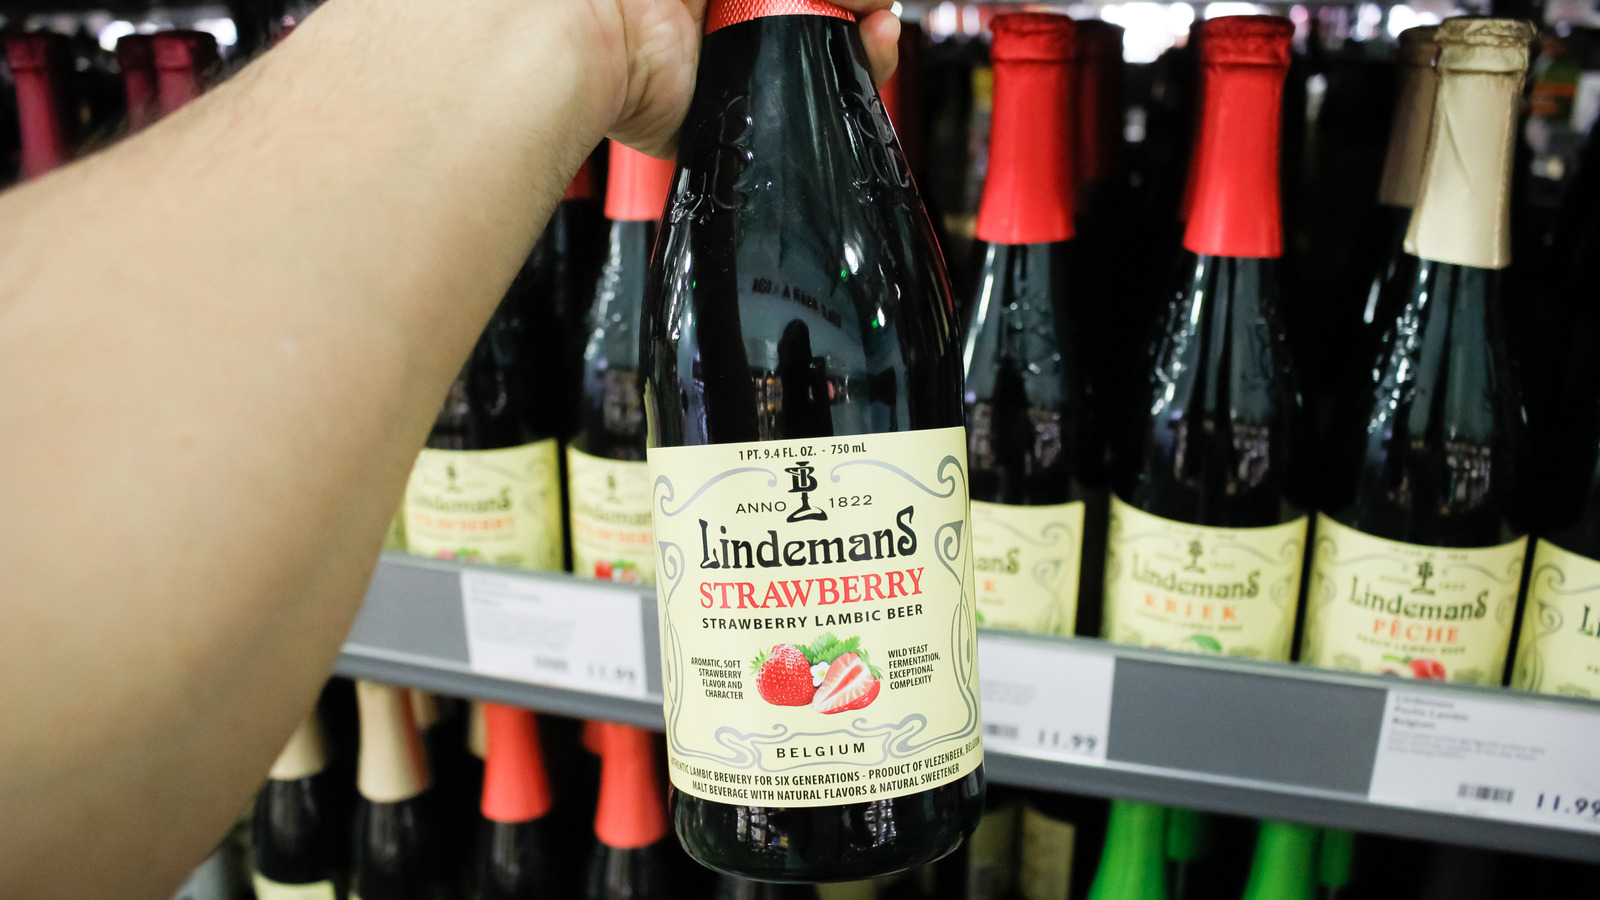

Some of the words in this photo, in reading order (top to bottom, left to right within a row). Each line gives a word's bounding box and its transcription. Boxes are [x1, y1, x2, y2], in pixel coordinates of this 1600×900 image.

[739, 450, 744, 460] 1
[747, 449, 762, 460] PT.
[764, 448, 780, 459] 9.4
[783, 447, 797, 458] FL.
[800, 446, 816, 457] OZ.
[831, 444, 849, 455] 750
[852, 442, 867, 453] mL
[735, 501, 787, 514] ANNO
[828, 495, 873, 508] 1822
[699, 567, 924, 609] STRAWBERRY
[702, 616, 808, 630] STRAWBERRY
[815, 609, 881, 627] LAMBIC
[887, 603, 923, 620] BEER
[888, 648, 908, 658] WILD
[908, 644, 928, 655] YEAST
[691, 657, 723, 668] AROMATIC,
[724, 660, 741, 668] SOFT
[889, 652, 941, 669] FERMENTATION,
[699, 668, 742, 679] STRAWBERRY
[890, 664, 934, 680] EXCEPTIONAL
[702, 679, 726, 688] FLAVOR
[728, 681, 743, 689] AND
[890, 675, 932, 690] COMPLEXITY
[705, 689, 744, 700] CHARACTER
[776, 742, 866, 759] BELGIUM
[690, 766, 712, 781] LAMBIC
[714, 771, 752, 785] BREWERY
[755, 775, 772, 786] FOR
[775, 775, 790, 786] SIX
[792, 771, 860, 786] GENERATIONS
[869, 763, 910, 780] PRODUCT
[912, 761, 923, 772] OF
[924, 746, 965, 769] VLEZENBEEK,
[692, 780, 708, 793] MALT
[709, 784, 748, 799] BEVERAGE
[750, 789, 774, 800] WITH
[777, 789, 821, 801] NATURAL
[824, 785, 867, 799] FLAVORS
[870, 784, 877, 794] &
[879, 779, 919, 793] NATURAL
[921, 763, 960, 784] SWEETENER
